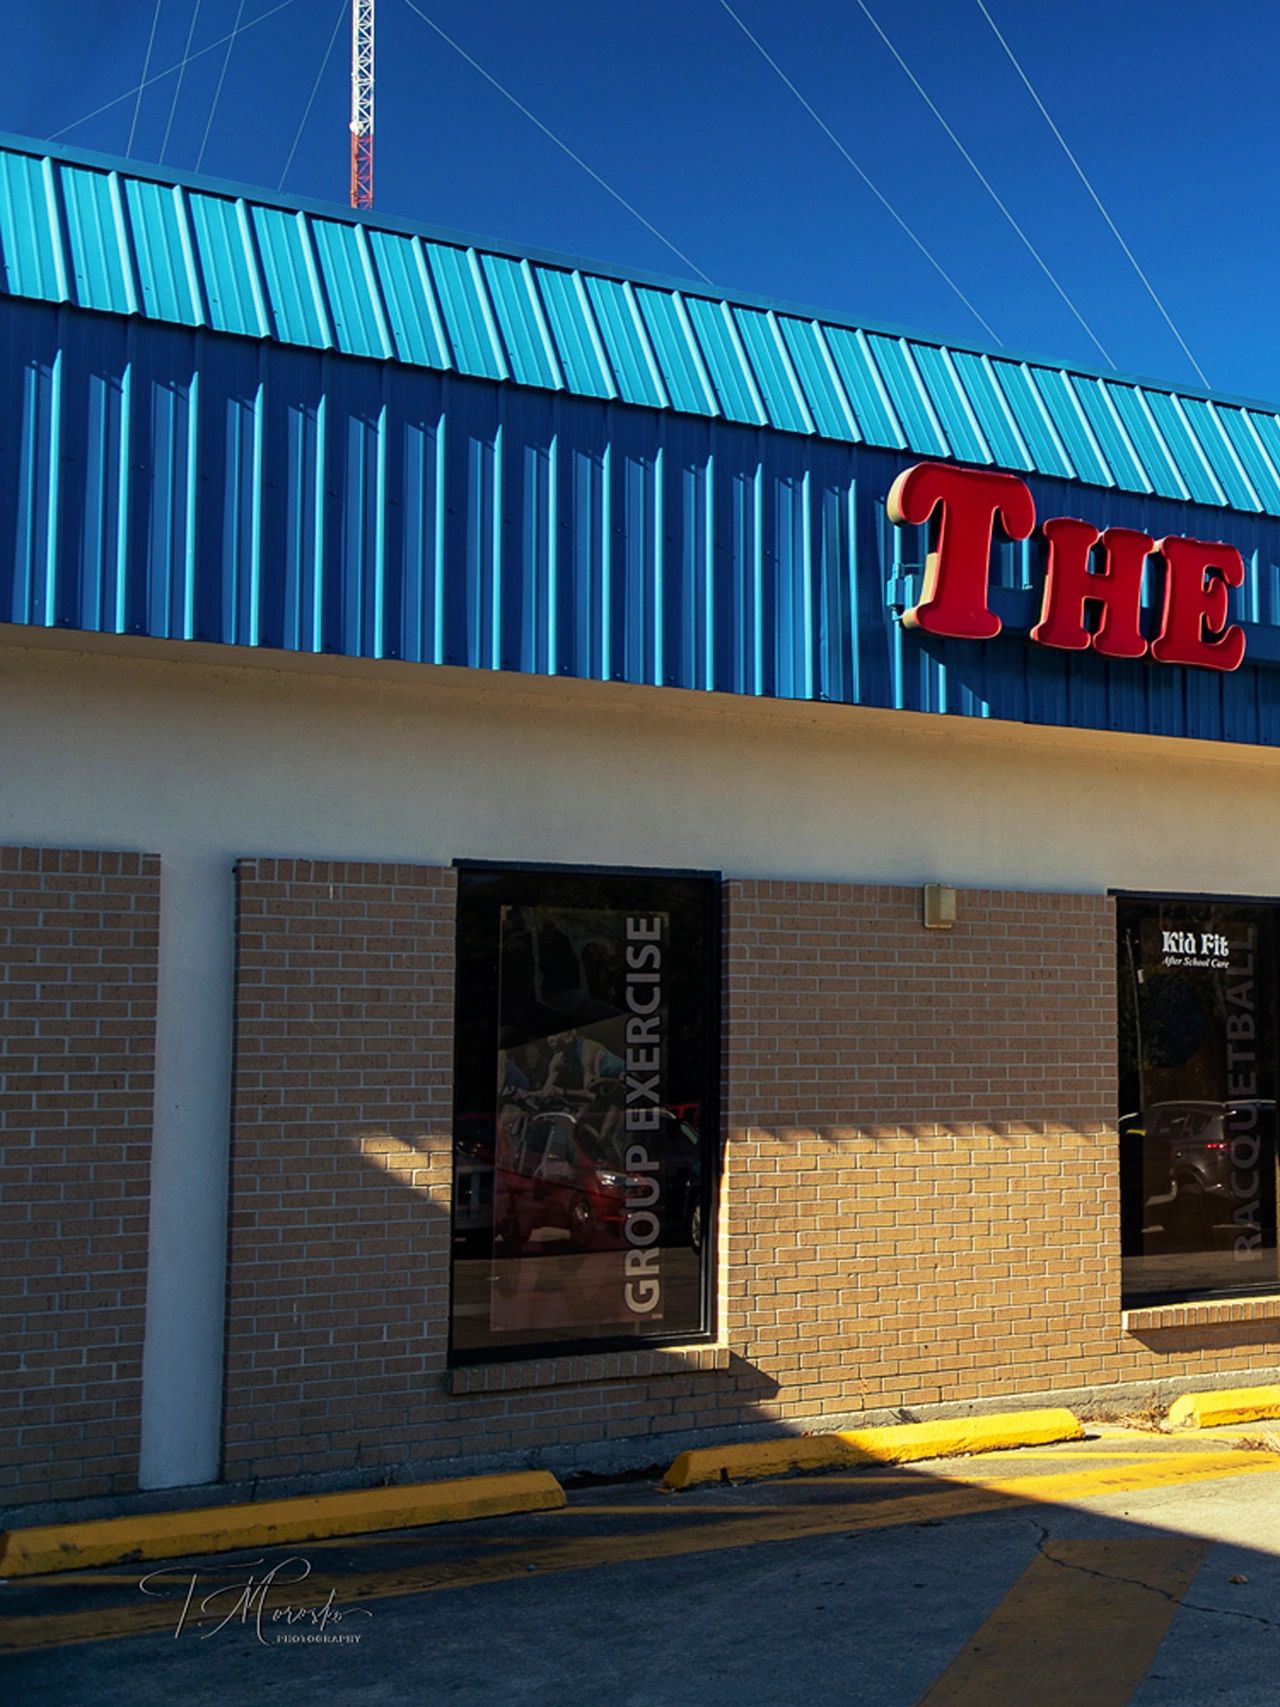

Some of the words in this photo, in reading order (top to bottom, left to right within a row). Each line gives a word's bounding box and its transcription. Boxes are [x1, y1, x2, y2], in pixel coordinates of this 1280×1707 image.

[887, 461, 1246, 672] THE
[624, 916, 662, 1131] EXERCISE
[1162, 931, 1197, 954] Kid
[1200, 933, 1229, 957] Fit
[1162, 956, 1182, 967] After
[1183, 957, 1210, 967] School
[1210, 959, 1229, 969] Care
[1227, 927, 1263, 1262] RACQUETBALL
[624, 1143, 662, 1315] GROUP
